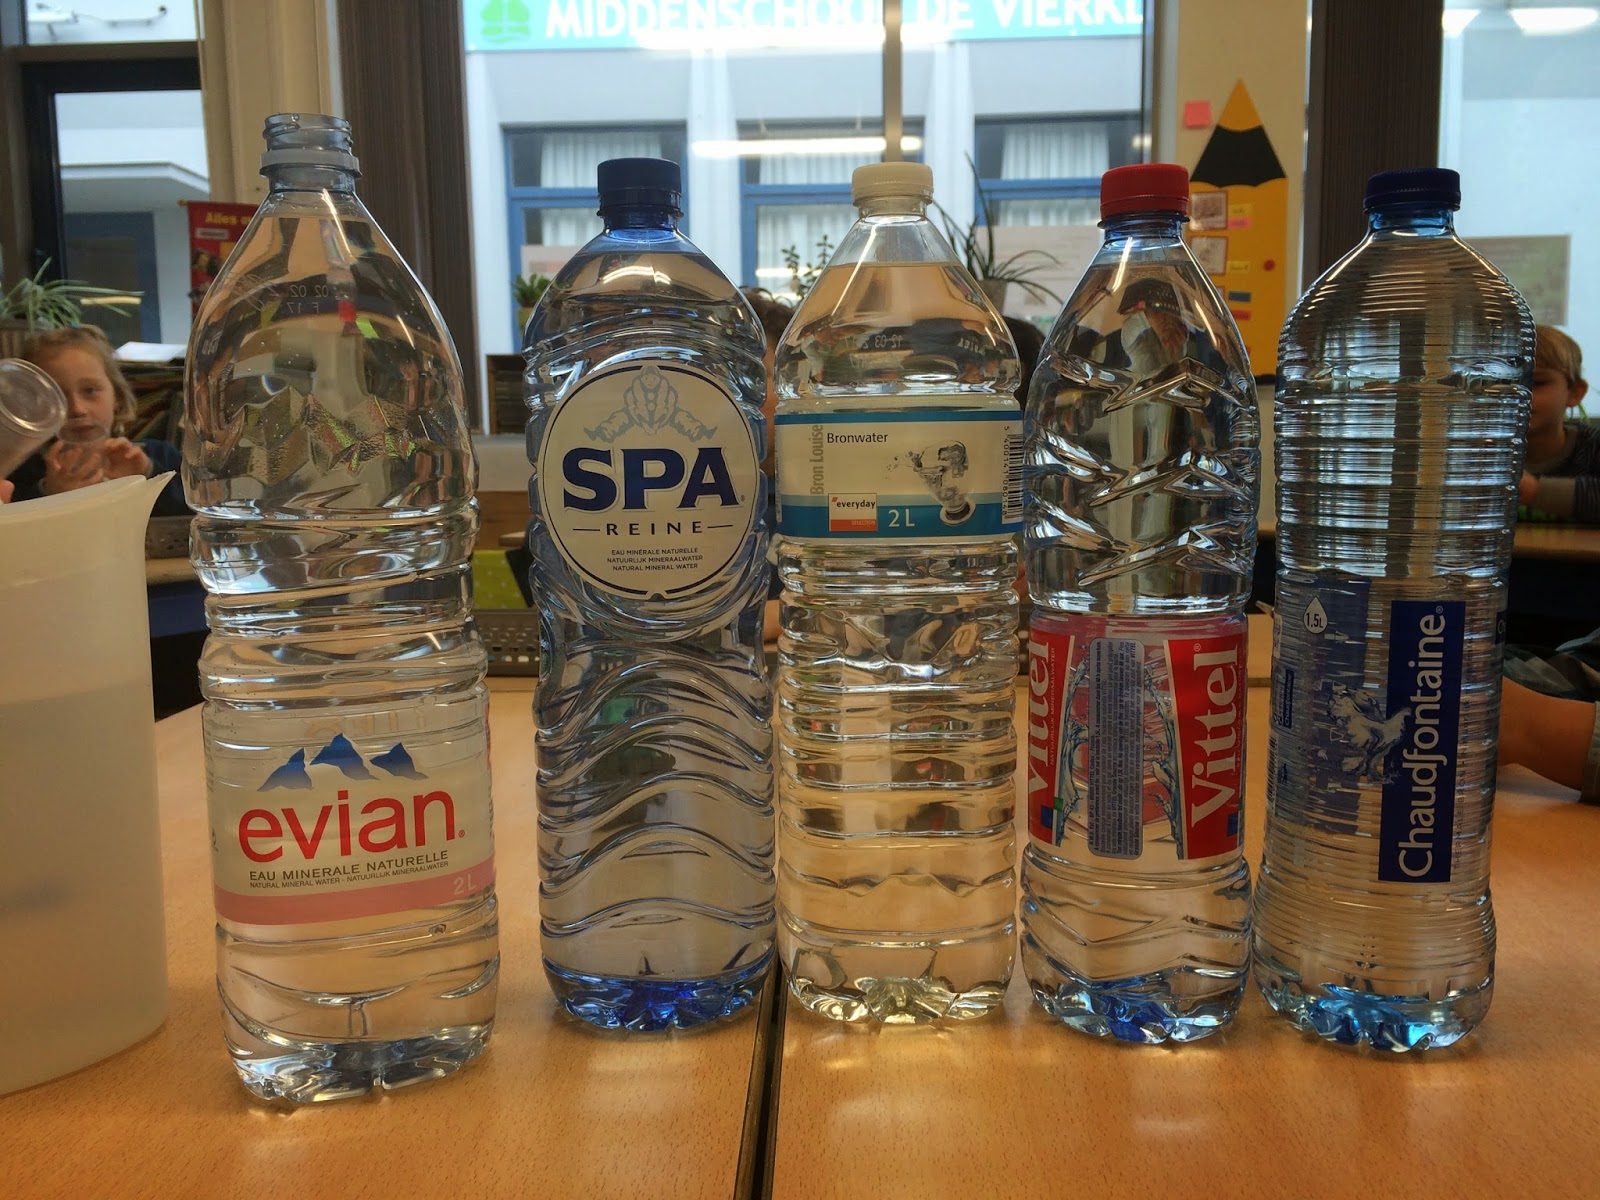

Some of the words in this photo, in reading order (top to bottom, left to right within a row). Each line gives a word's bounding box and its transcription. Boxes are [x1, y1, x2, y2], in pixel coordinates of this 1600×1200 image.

[917, 0, 974, 29] DE
[809, 424, 824, 462] Louise
[827, 432, 888, 443] Bronwater
[562, 447, 739, 511] SPA
[810, 466, 824, 495] Bron
[837, 500, 876, 509] everyday
[606, 521, 702, 536] REINE
[1306, 612, 1324, 629] 1.5L
[1192, 648, 1238, 827] Vittel
[1399, 614, 1447, 878] Chaudfontaine
[238, 790, 456, 863] evian
[250, 870, 276, 881] EAU
[282, 864, 360, 880] MINERALE
[367, 850, 448, 872] NATURELLE
[282, 879, 313, 887] MINERAL
[347, 870, 390, 882] NATUURLIJK
[392, 861, 449, 875] MINERAALWATER
